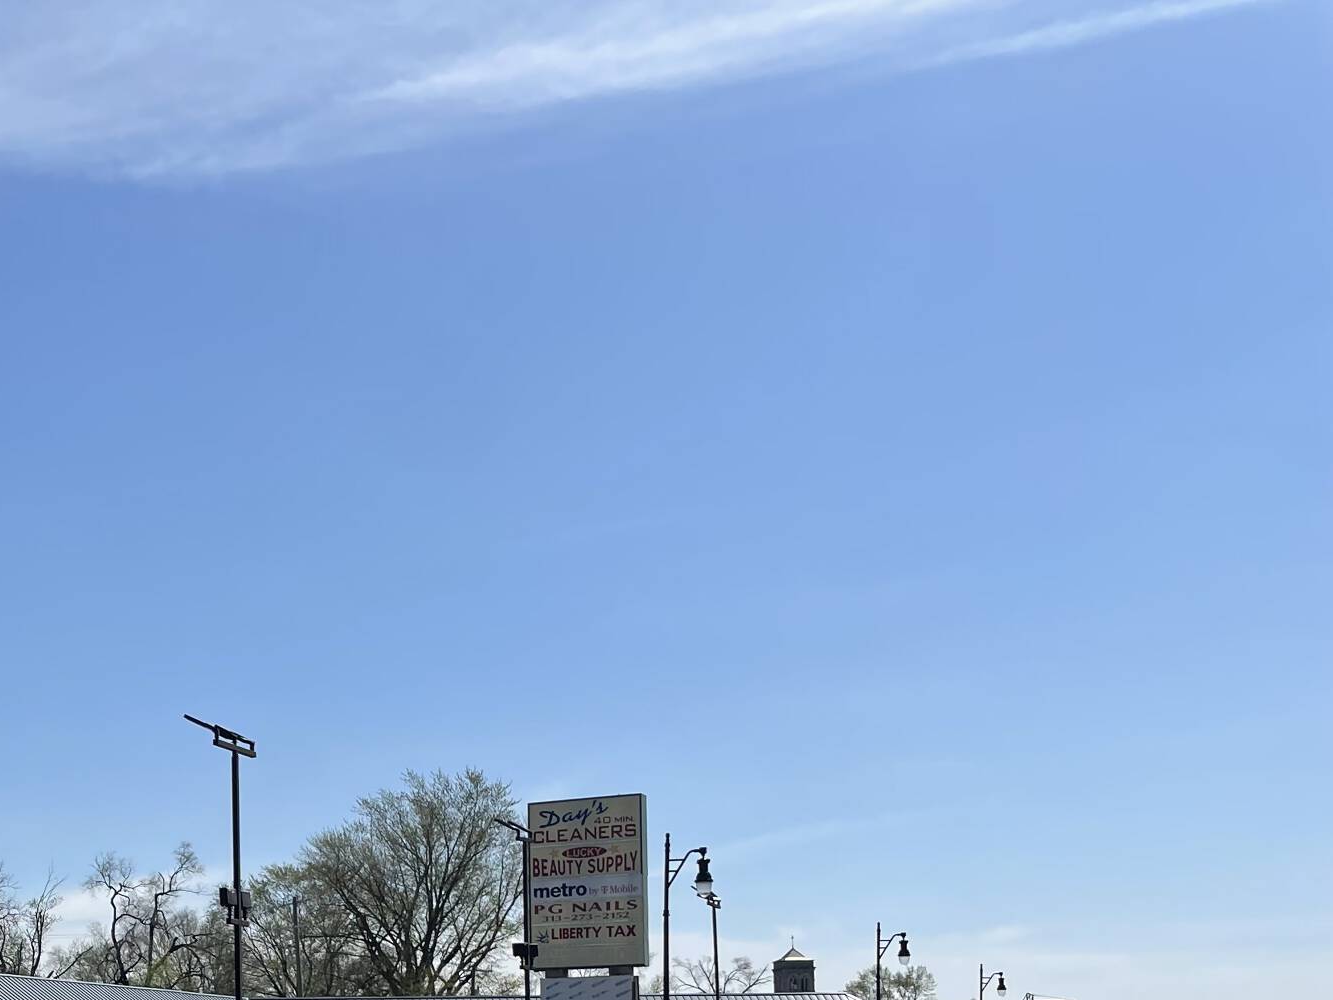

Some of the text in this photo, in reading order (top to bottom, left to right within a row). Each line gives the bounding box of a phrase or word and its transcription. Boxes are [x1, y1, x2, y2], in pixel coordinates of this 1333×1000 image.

[539, 800, 609, 829] Day's
[594, 816, 611, 824] 40
[533, 824, 637, 844] CLEANERS
[566, 847, 602, 858] LUCKY
[532, 850, 638, 877] BEAUTY SUPPLY
[533, 883, 587, 899] metro
[588, 886, 600, 896] by
[534, 899, 638, 915] PG NAILS
[551, 924, 637, 940] LIBERTY TAX
